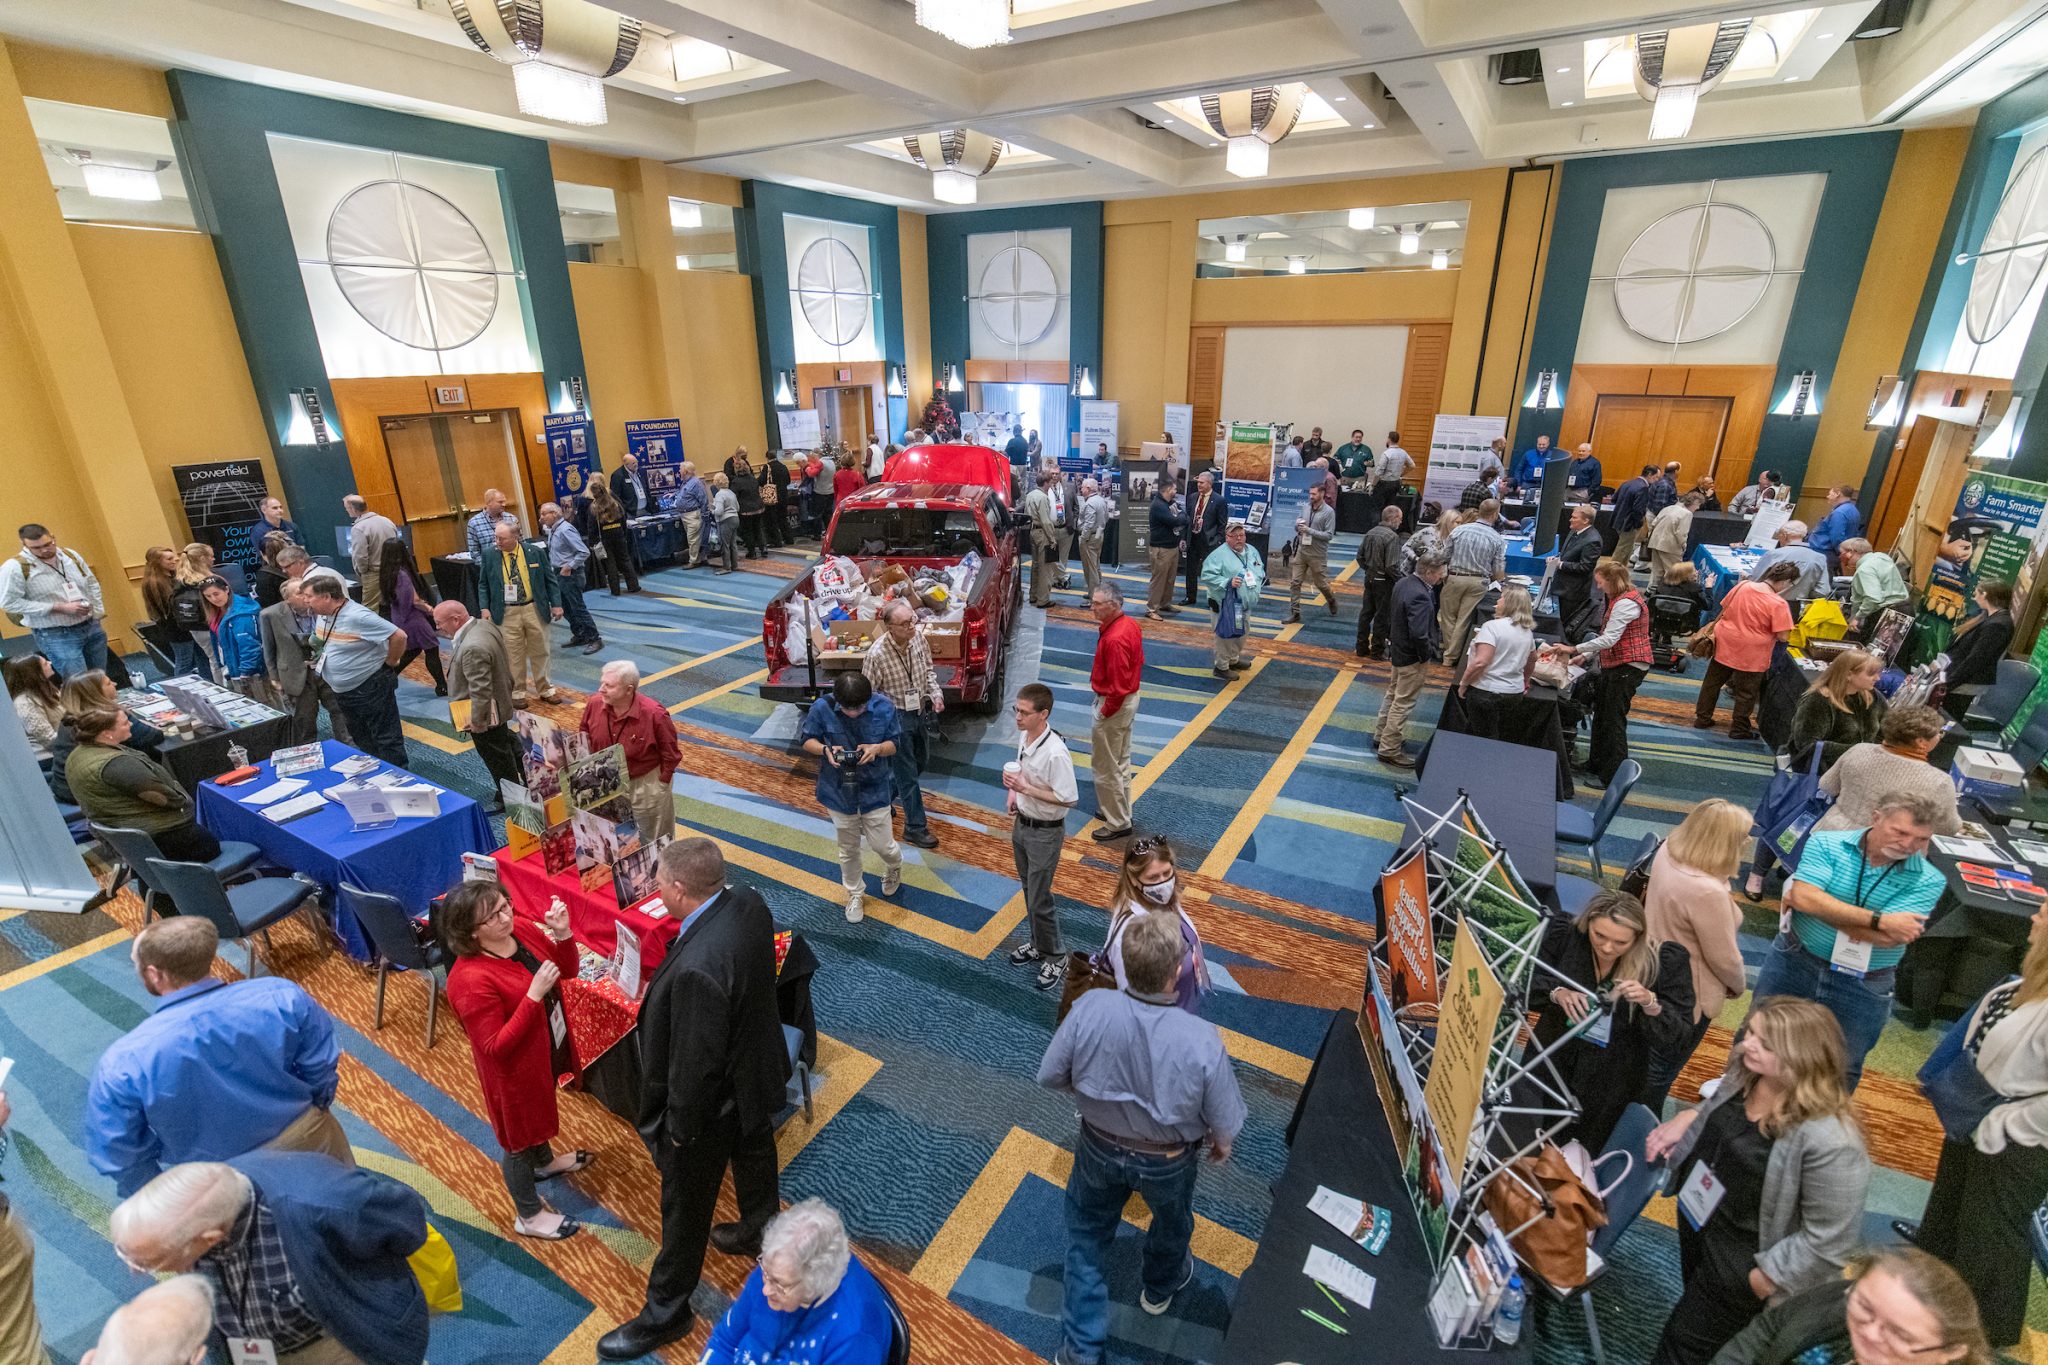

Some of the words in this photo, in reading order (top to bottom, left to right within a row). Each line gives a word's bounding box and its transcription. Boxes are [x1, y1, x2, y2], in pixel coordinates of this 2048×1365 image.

[443, 389, 459, 402] EXIT
[546, 415, 574, 426] MARYLAND
[575, 414, 585, 422] FFA
[640, 422, 679, 430] FOUNDATION
[190, 464, 249, 481] powerfield
[1985, 494, 2007, 508] Farm
[2007, 499, 2043, 516] Smarter
[221, 525, 254, 538] Your
[221, 546, 258, 561] powe
[821, 587, 842, 598] drive
[843, 586, 853, 595] up
[1399, 879, 1426, 937] lending
[1393, 900, 1420, 947] support
[1419, 937, 1428, 961] to
[1388, 914, 1428, 991] Agriculture
[1458, 983, 1479, 1033] FARM
[1453, 993, 1480, 1053] CREDIT
